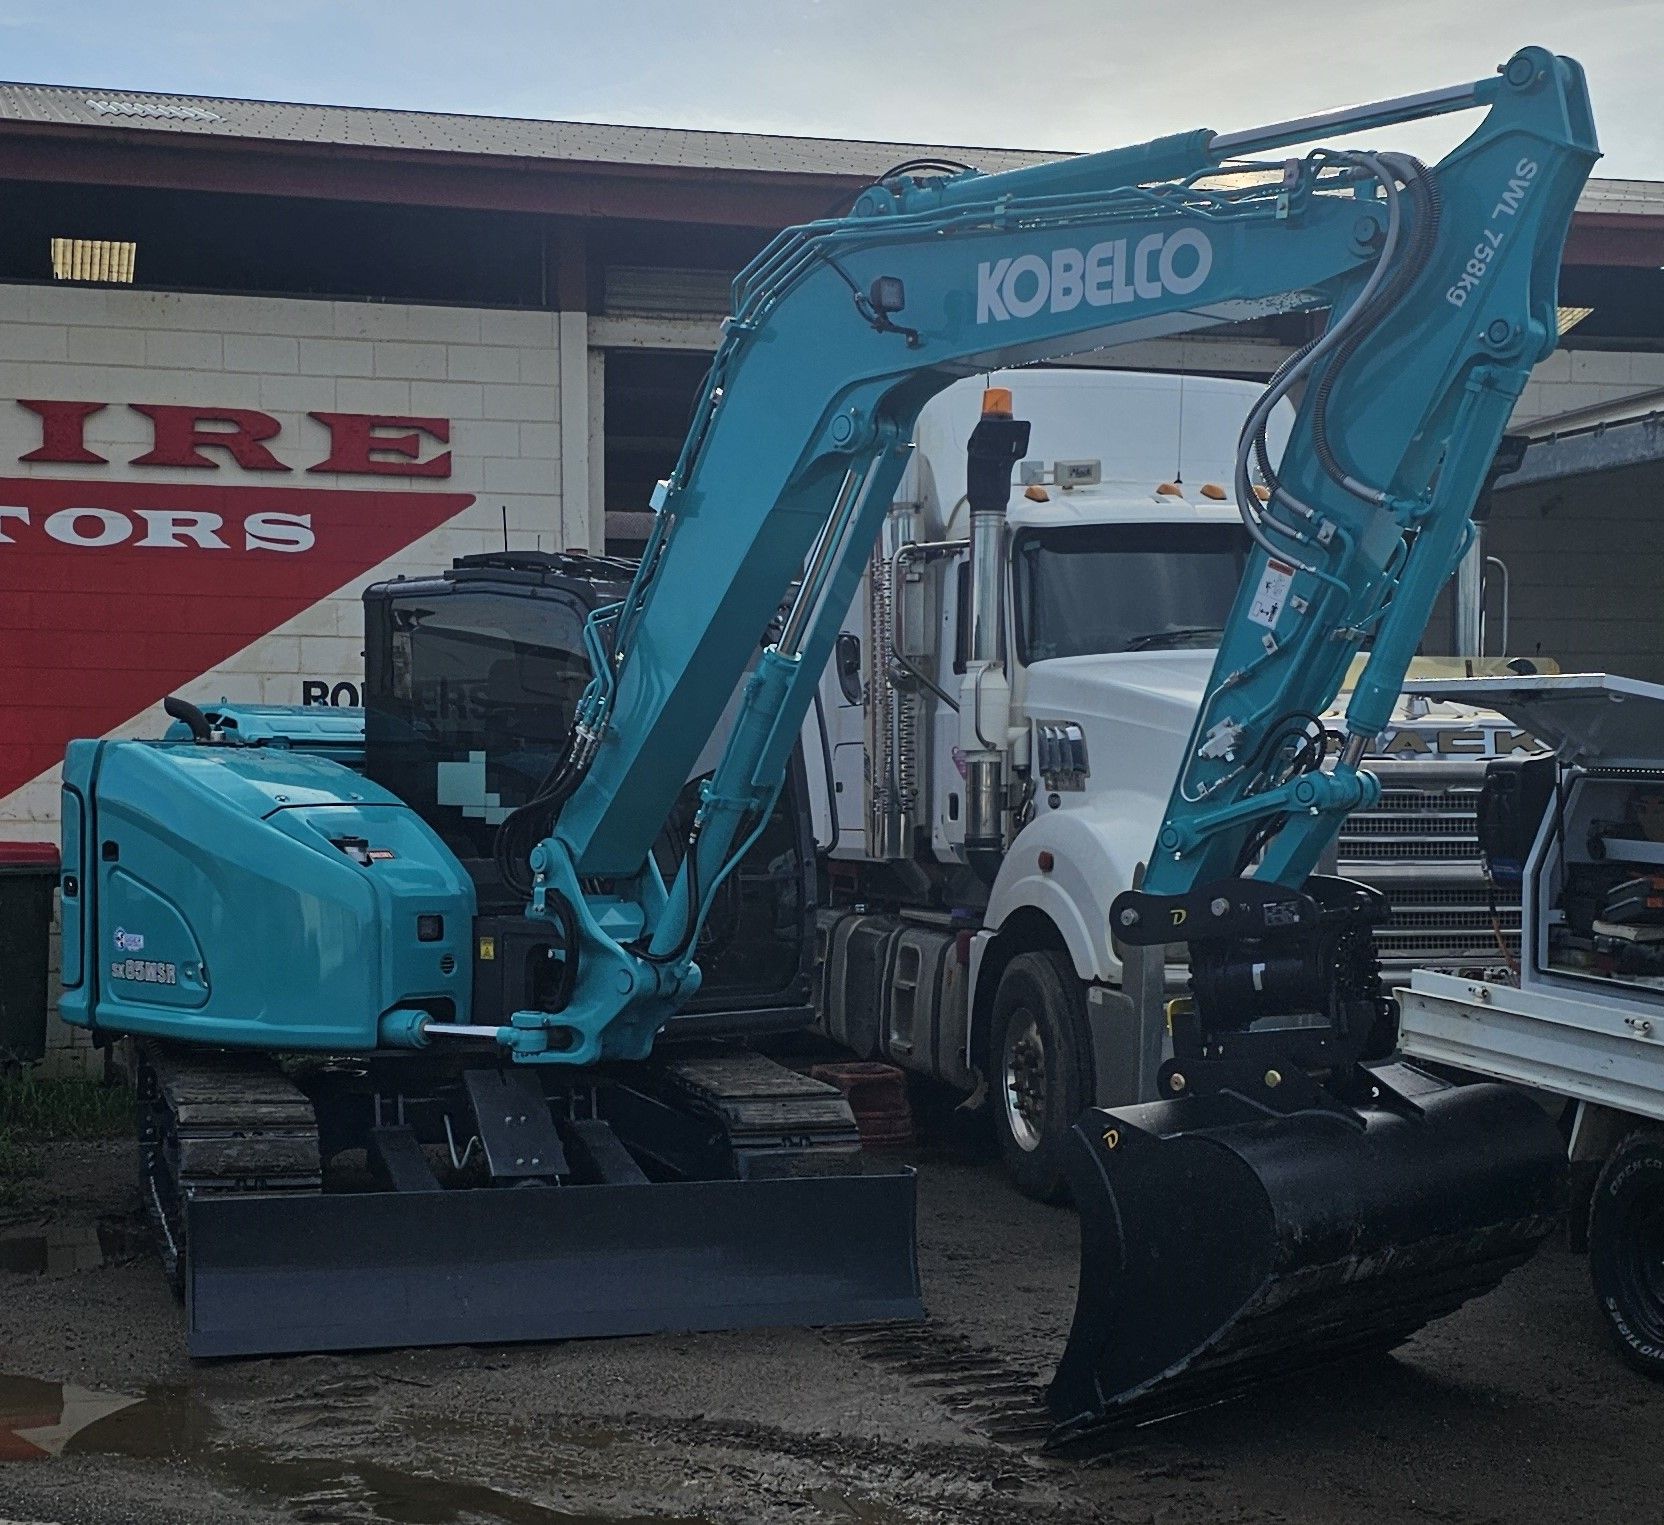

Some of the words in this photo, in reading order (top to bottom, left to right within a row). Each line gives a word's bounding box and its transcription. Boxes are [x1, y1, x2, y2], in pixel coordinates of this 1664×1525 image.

[1492, 157, 1537, 219] SWL
[976, 227, 1213, 325] KOBELCO
[1446, 229, 1504, 307] 758kg
